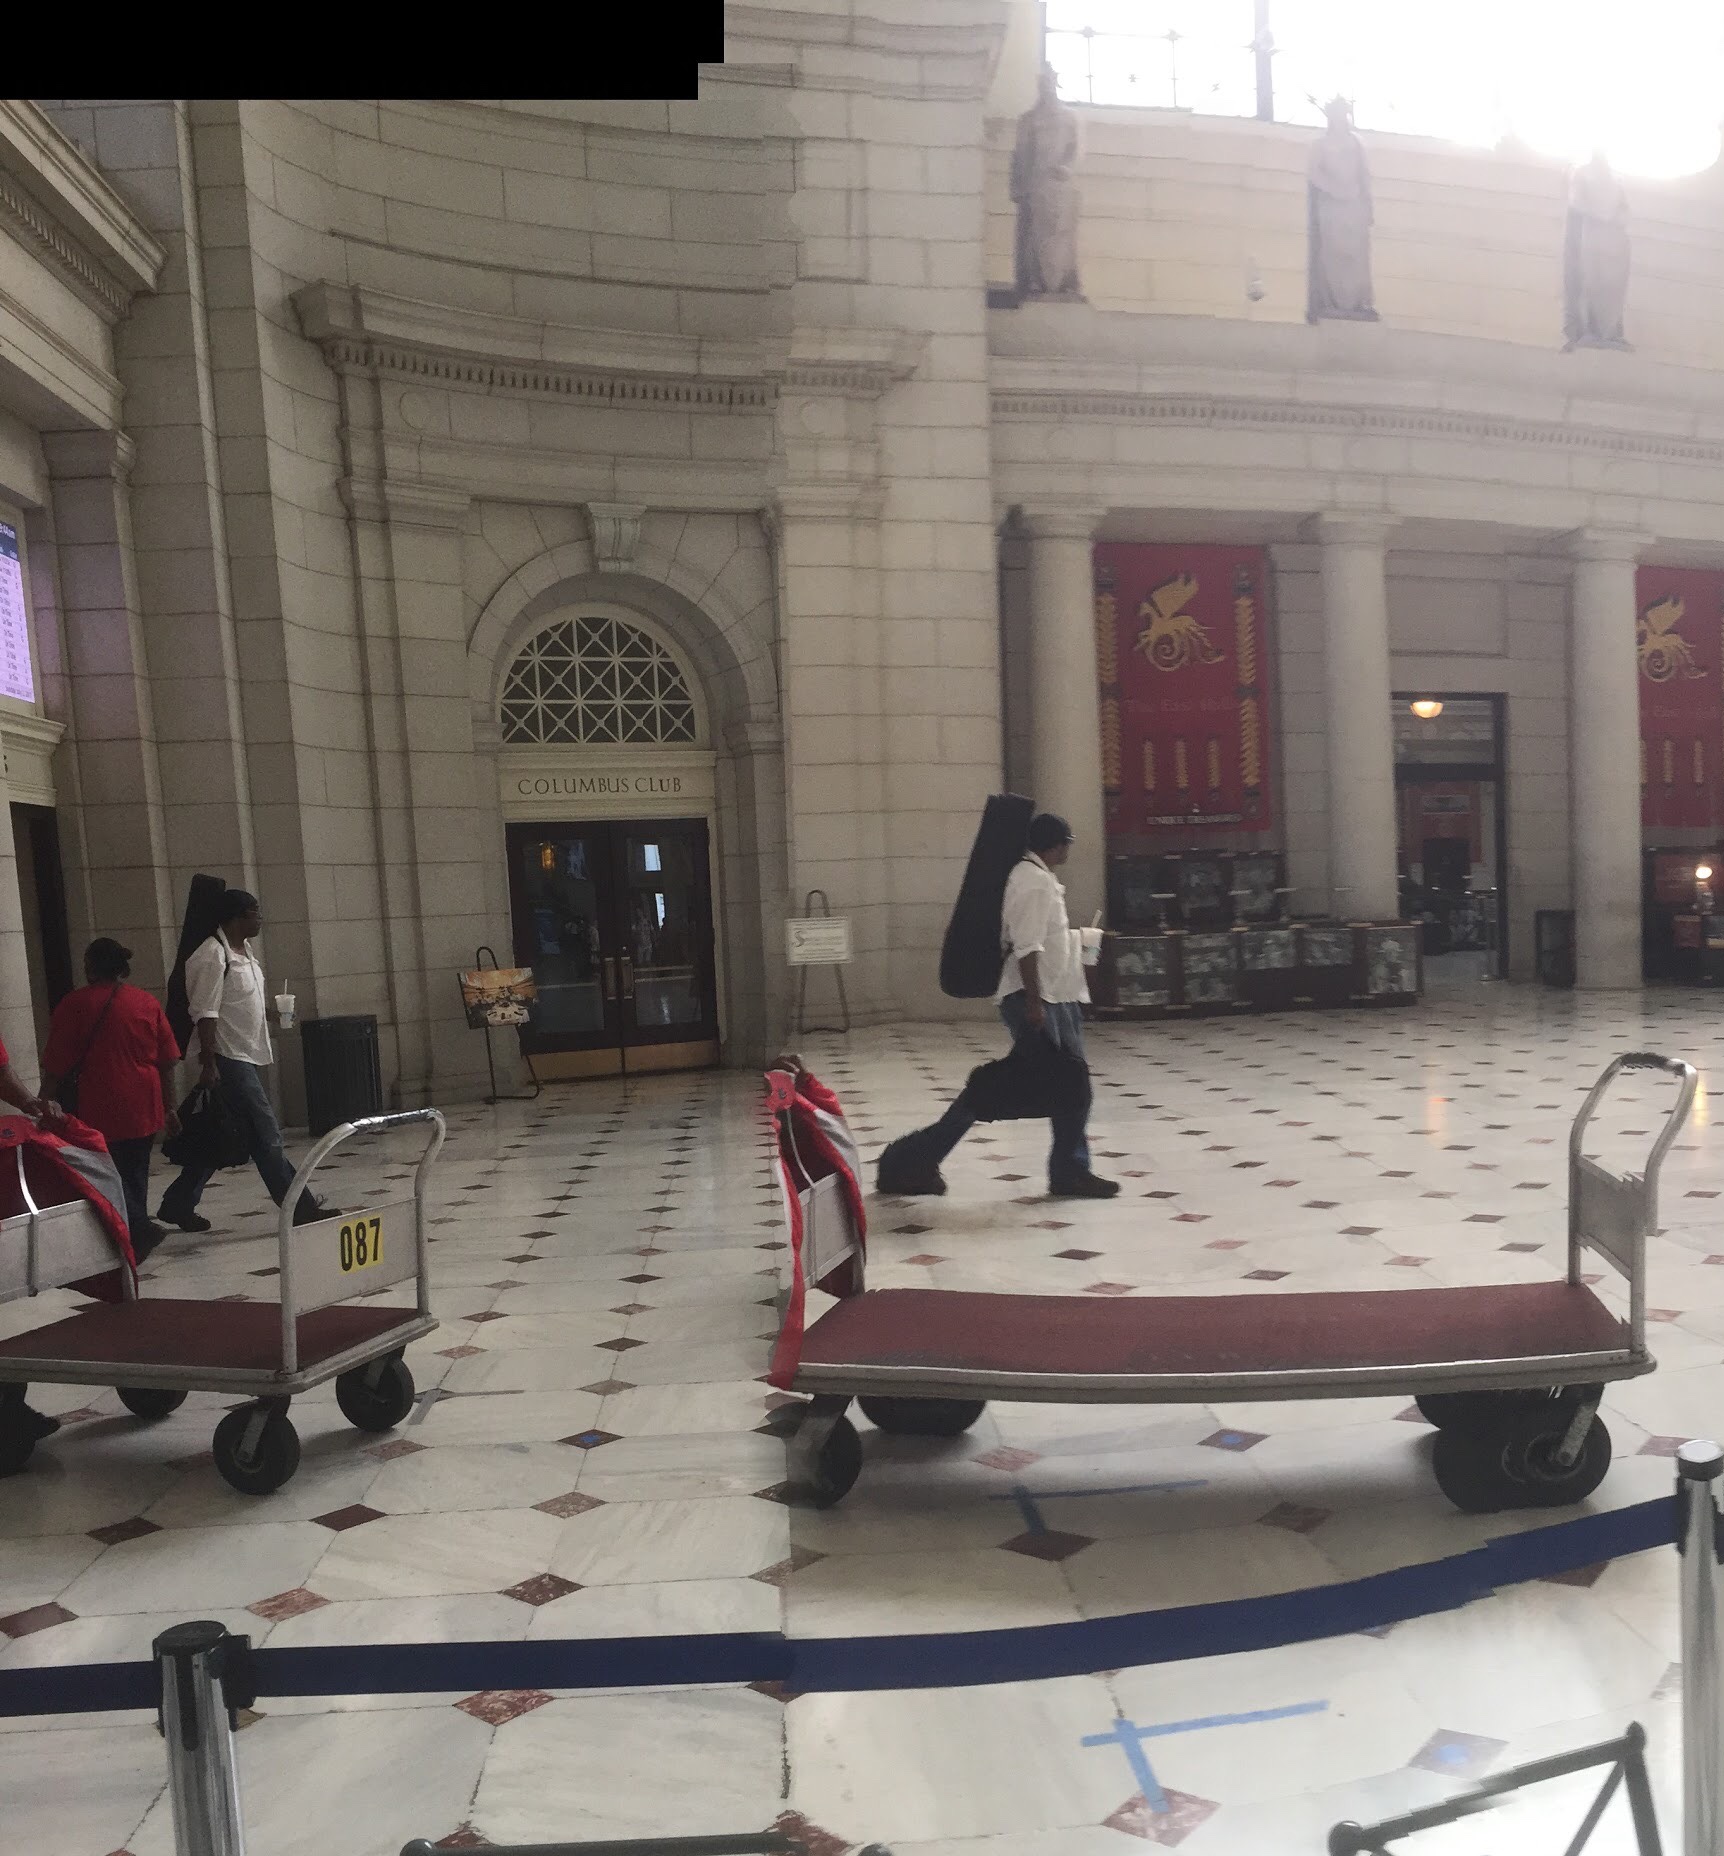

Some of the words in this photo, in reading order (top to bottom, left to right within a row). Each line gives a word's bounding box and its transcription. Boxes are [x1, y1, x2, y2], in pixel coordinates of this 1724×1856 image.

[518, 778, 630, 795] COLUMBUS
[635, 777, 682, 793] CLUB
[340, 1217, 380, 1271] 087
